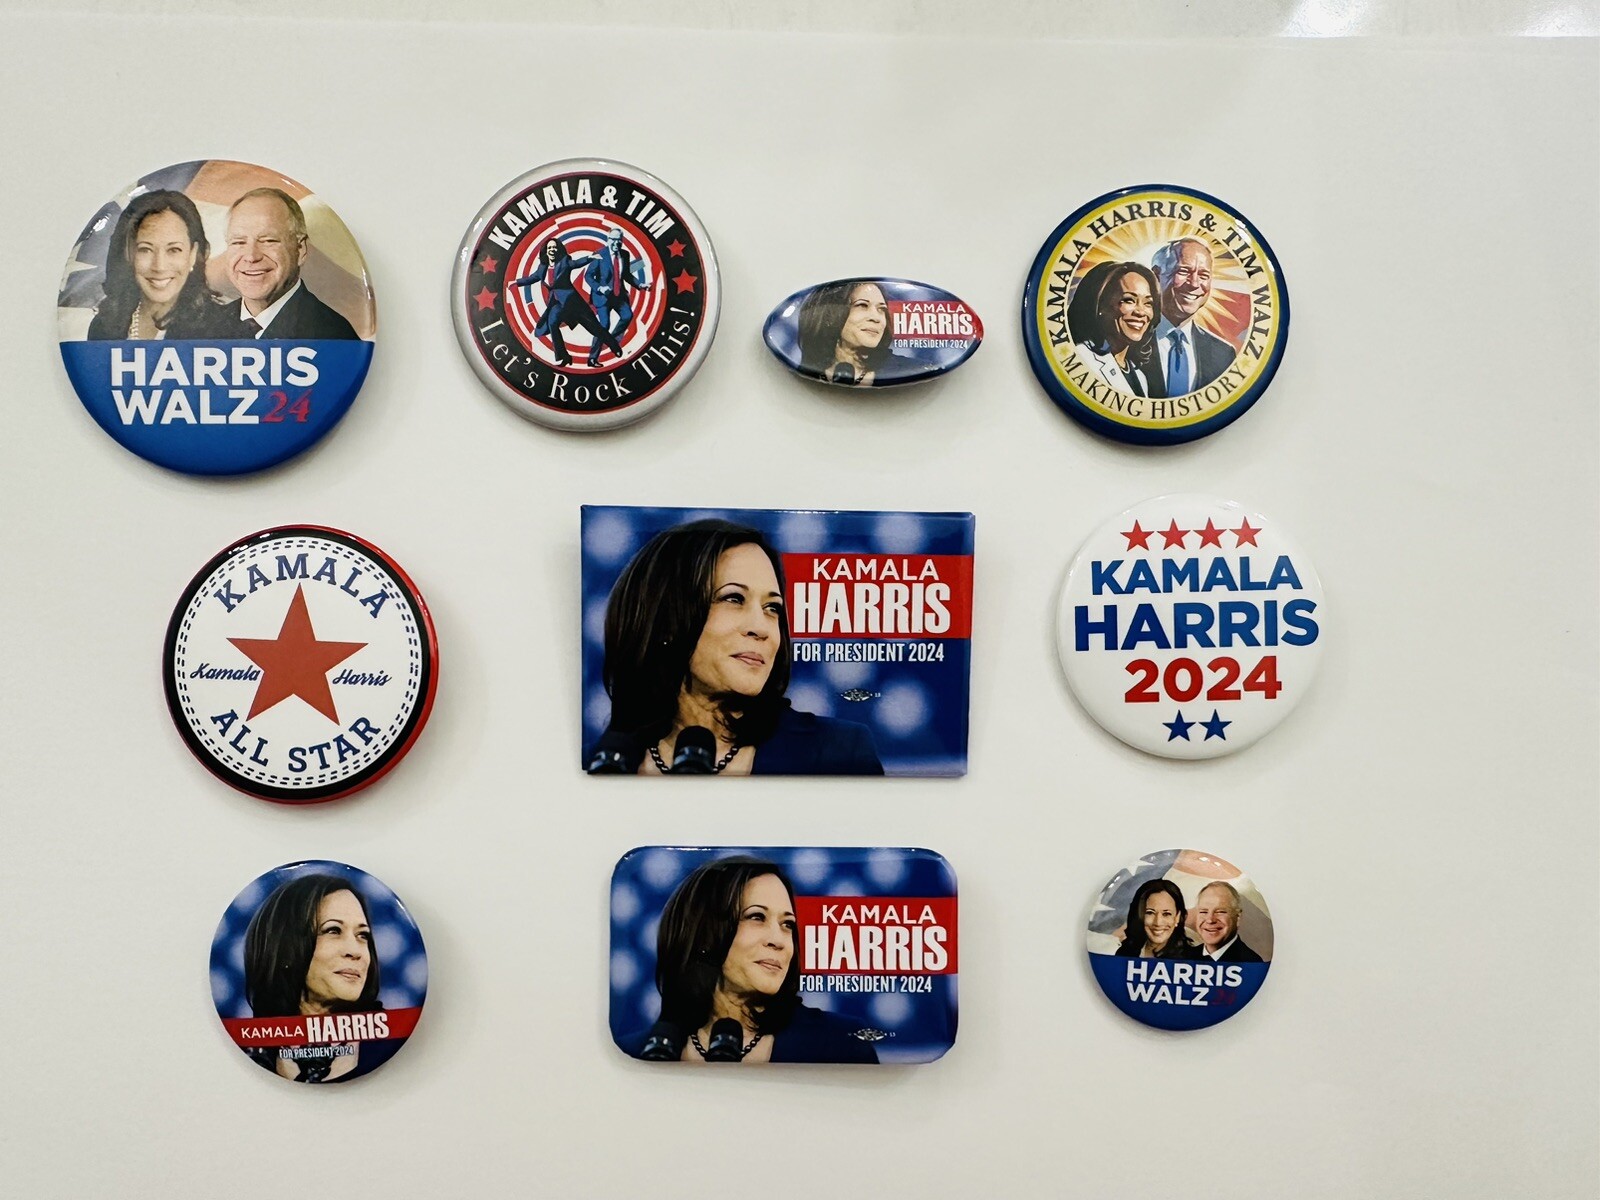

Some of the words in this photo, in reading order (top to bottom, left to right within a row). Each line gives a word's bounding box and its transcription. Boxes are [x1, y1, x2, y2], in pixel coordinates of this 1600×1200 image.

[488, 179, 593, 251] KAMALA
[600, 185, 618, 209] &
[623, 190, 675, 240] TIM
[1047, 238, 1091, 347] KAMALA
[1086, 201, 1193, 239] HARRIS
[1198, 213, 1217, 232] &
[1221, 225, 1264, 279] TIM
[1244, 284, 1272, 362] WALZ
[893, 312, 973, 336] HARRIS
[902, 303, 966, 313] KAMALA
[478, 319, 539, 390] Let's
[548, 371, 633, 403] Rock
[631, 305, 696, 382] This!
[894, 339, 909, 348] FOR
[909, 339, 949, 349] PRESIDENT
[949, 339, 968, 350] 2024
[110, 346, 319, 387] HARRIS
[1060, 352, 1144, 418] MAKING
[1150, 364, 1248, 419] HISTORY
[111, 389, 259, 425] WALZ
[260, 388, 314, 423] 24
[213, 553, 391, 619] KAMALA
[813, 558, 940, 581] KAMALA
[1091, 555, 1303, 595] KAMALA
[793, 582, 951, 634] HARRIS
[1074, 598, 1320, 652] HARRIS
[793, 643, 821, 662] FOR
[825, 643, 905, 662] PRESIDENT
[908, 643, 944, 662] 2024
[189, 662, 261, 682] Kamala
[332, 669, 392, 687] Harris
[1124, 655, 1282, 703] 2024
[210, 709, 269, 767] ALL
[288, 716, 381, 773] STAR
[822, 904, 937, 924] KAMALA
[804, 925, 948, 971] HARRIS
[800, 975, 824, 992] FOR
[827, 975, 897, 993] PRESIDENT
[900, 976, 932, 993] 2024
[1126, 960, 1243, 987] HARRIS
[1126, 982, 1210, 1006] WALZ
[241, 1025, 304, 1039] KAMALA
[306, 1012, 390, 1043] HARRIS
[279, 1048, 294, 1059] FOR
[294, 1046, 334, 1059] PRESIDENT
[335, 1045, 355, 1057] 2024
